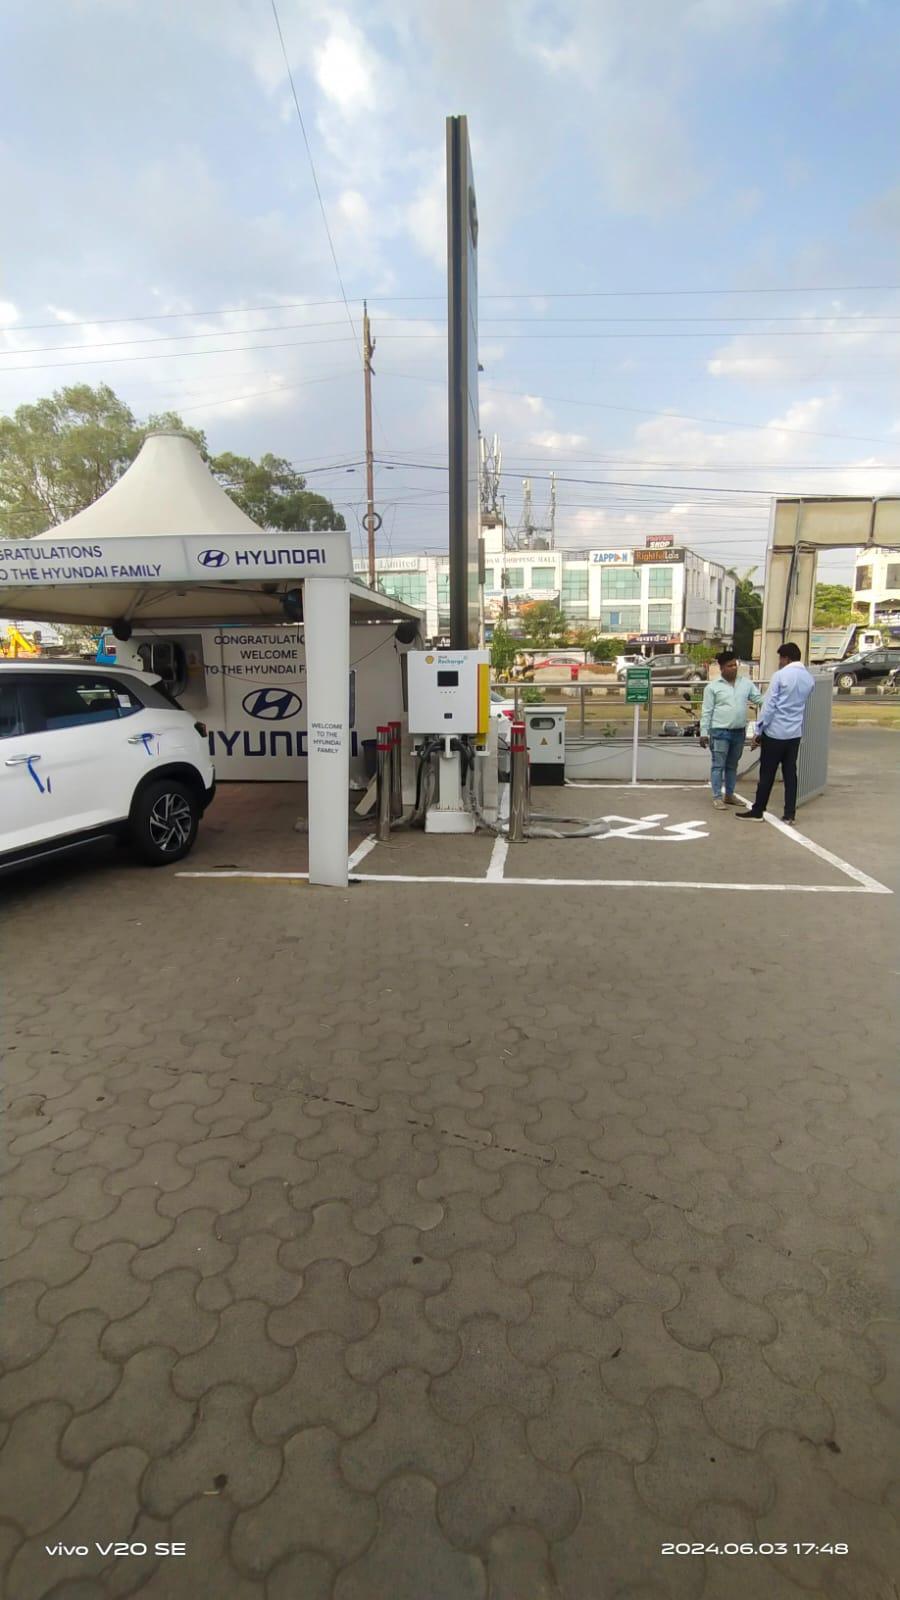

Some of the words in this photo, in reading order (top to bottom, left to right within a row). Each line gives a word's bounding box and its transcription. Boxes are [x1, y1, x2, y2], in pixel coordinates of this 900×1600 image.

[235, 549, 326, 565] HYUNDAI
[10, 568, 39, 580] THE
[42, 566, 108, 580] HYUNDAI
[111, 564, 161, 578] FAMILY
[240, 649, 298, 659] WELCOME
[205, 665, 219, 674] TO
[222, 665, 242, 674] THE
[245, 665, 297, 674] HYUNDAI
[312, 722, 343, 730] WELCOME
